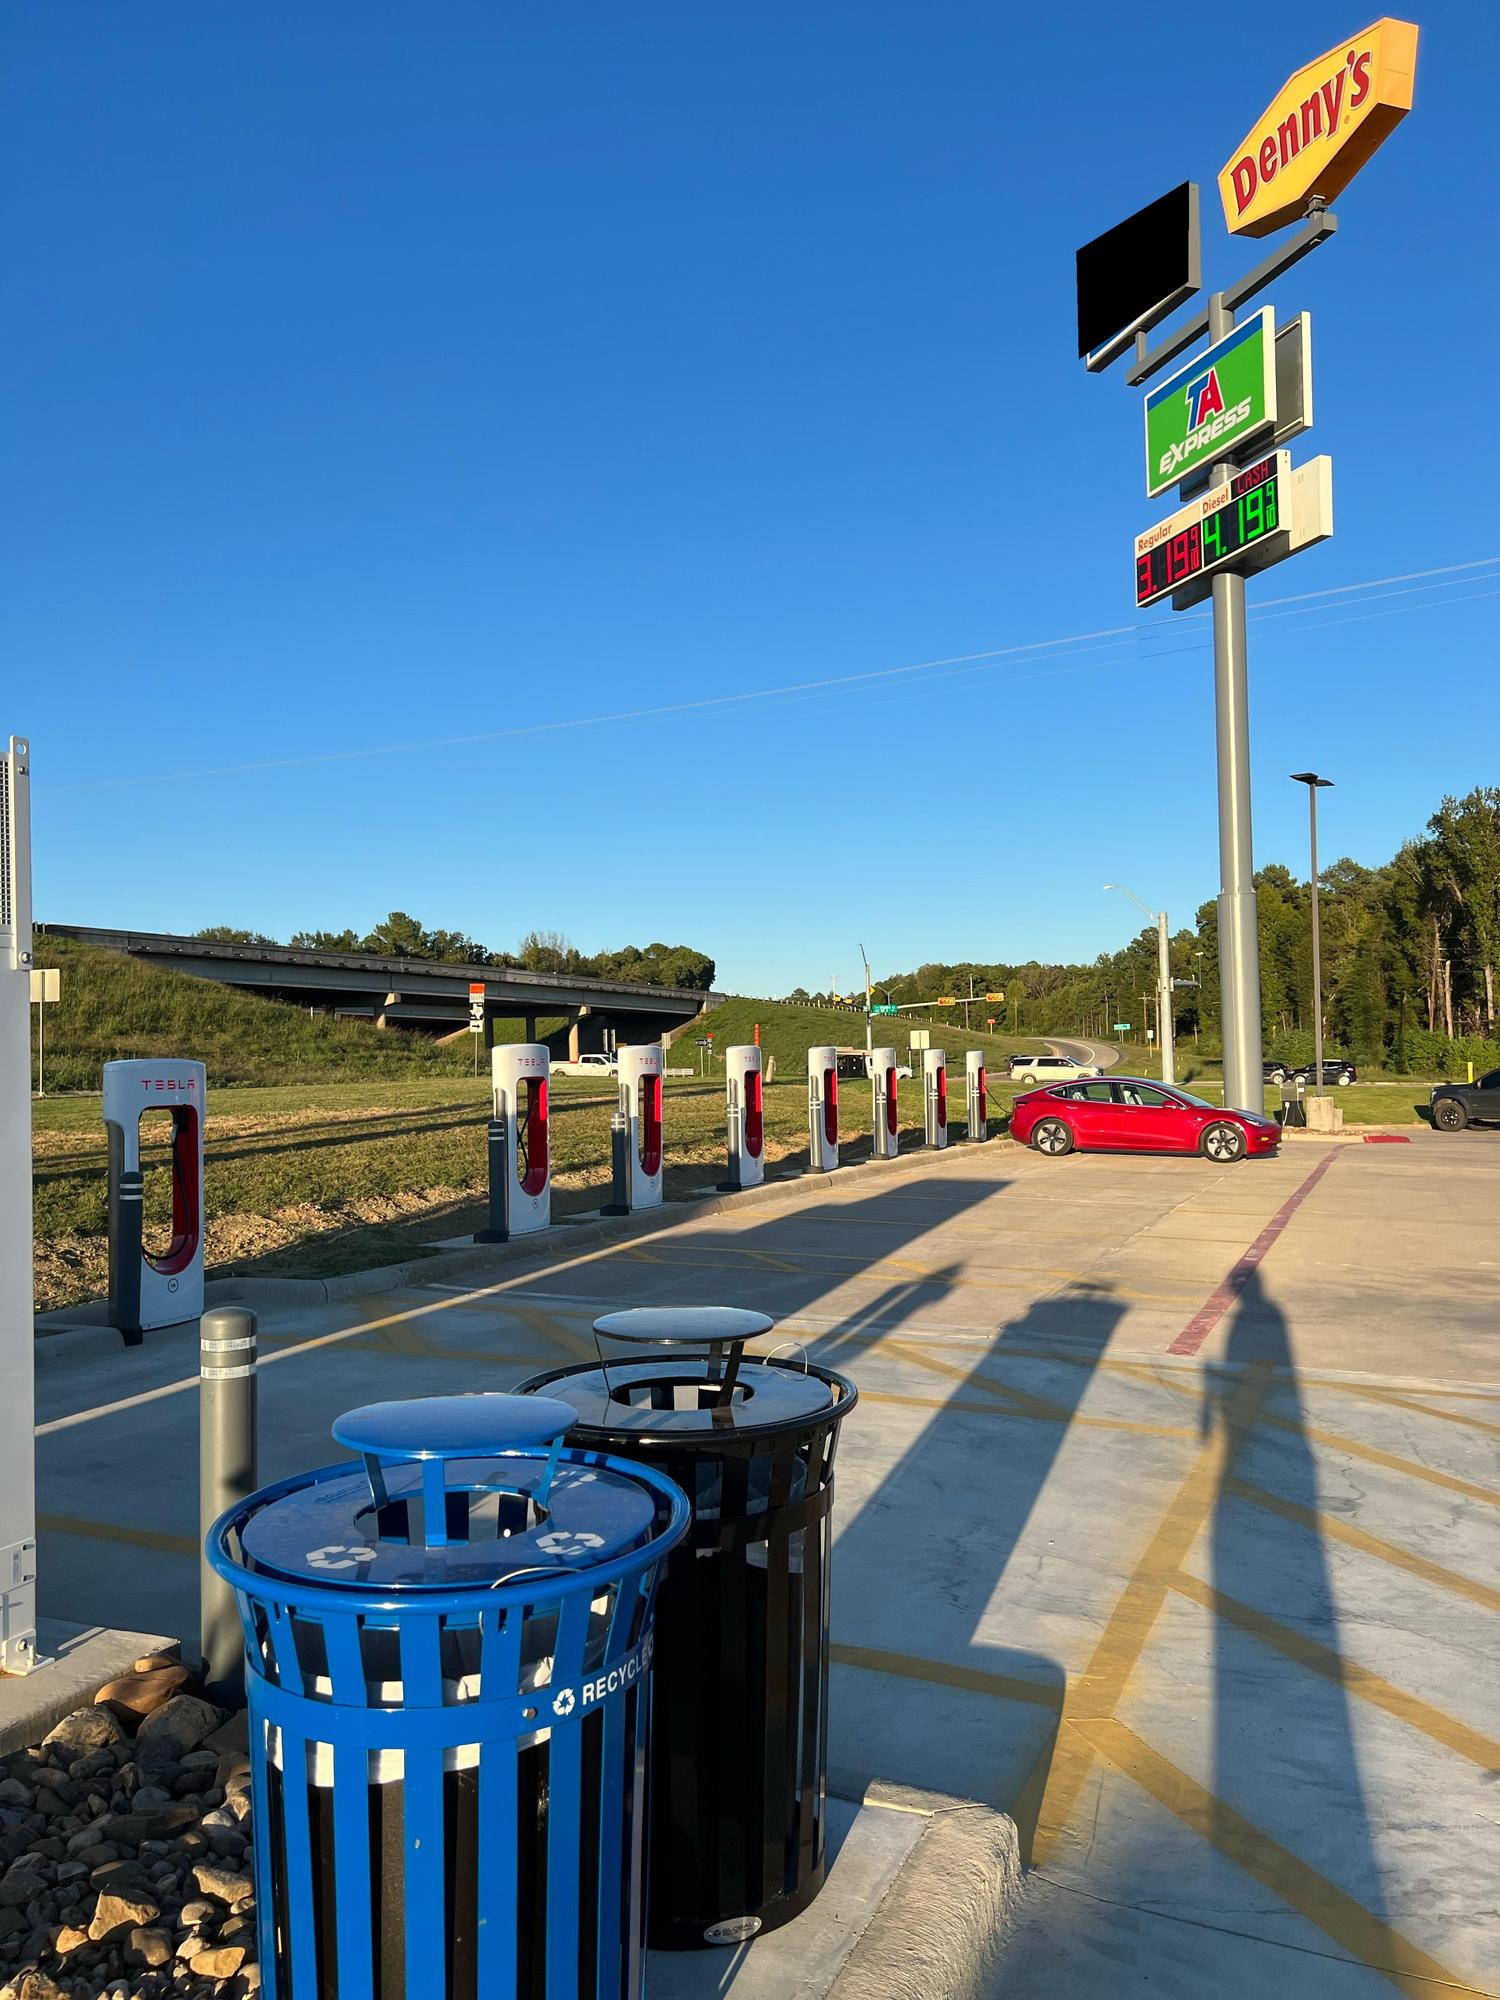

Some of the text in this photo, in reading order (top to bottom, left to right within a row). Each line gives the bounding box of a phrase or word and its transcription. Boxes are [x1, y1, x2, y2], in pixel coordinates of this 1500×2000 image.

[1230, 49, 1372, 217] Denny's
[1185, 366, 1225, 435] TA
[1159, 396, 1252, 475] EXPRESS
[1237, 460, 1269, 494] CASH
[1202, 488, 1229, 514] Diesel
[1138, 525, 1172, 553] Regular
[141, 1079, 195, 1091] TESLA
